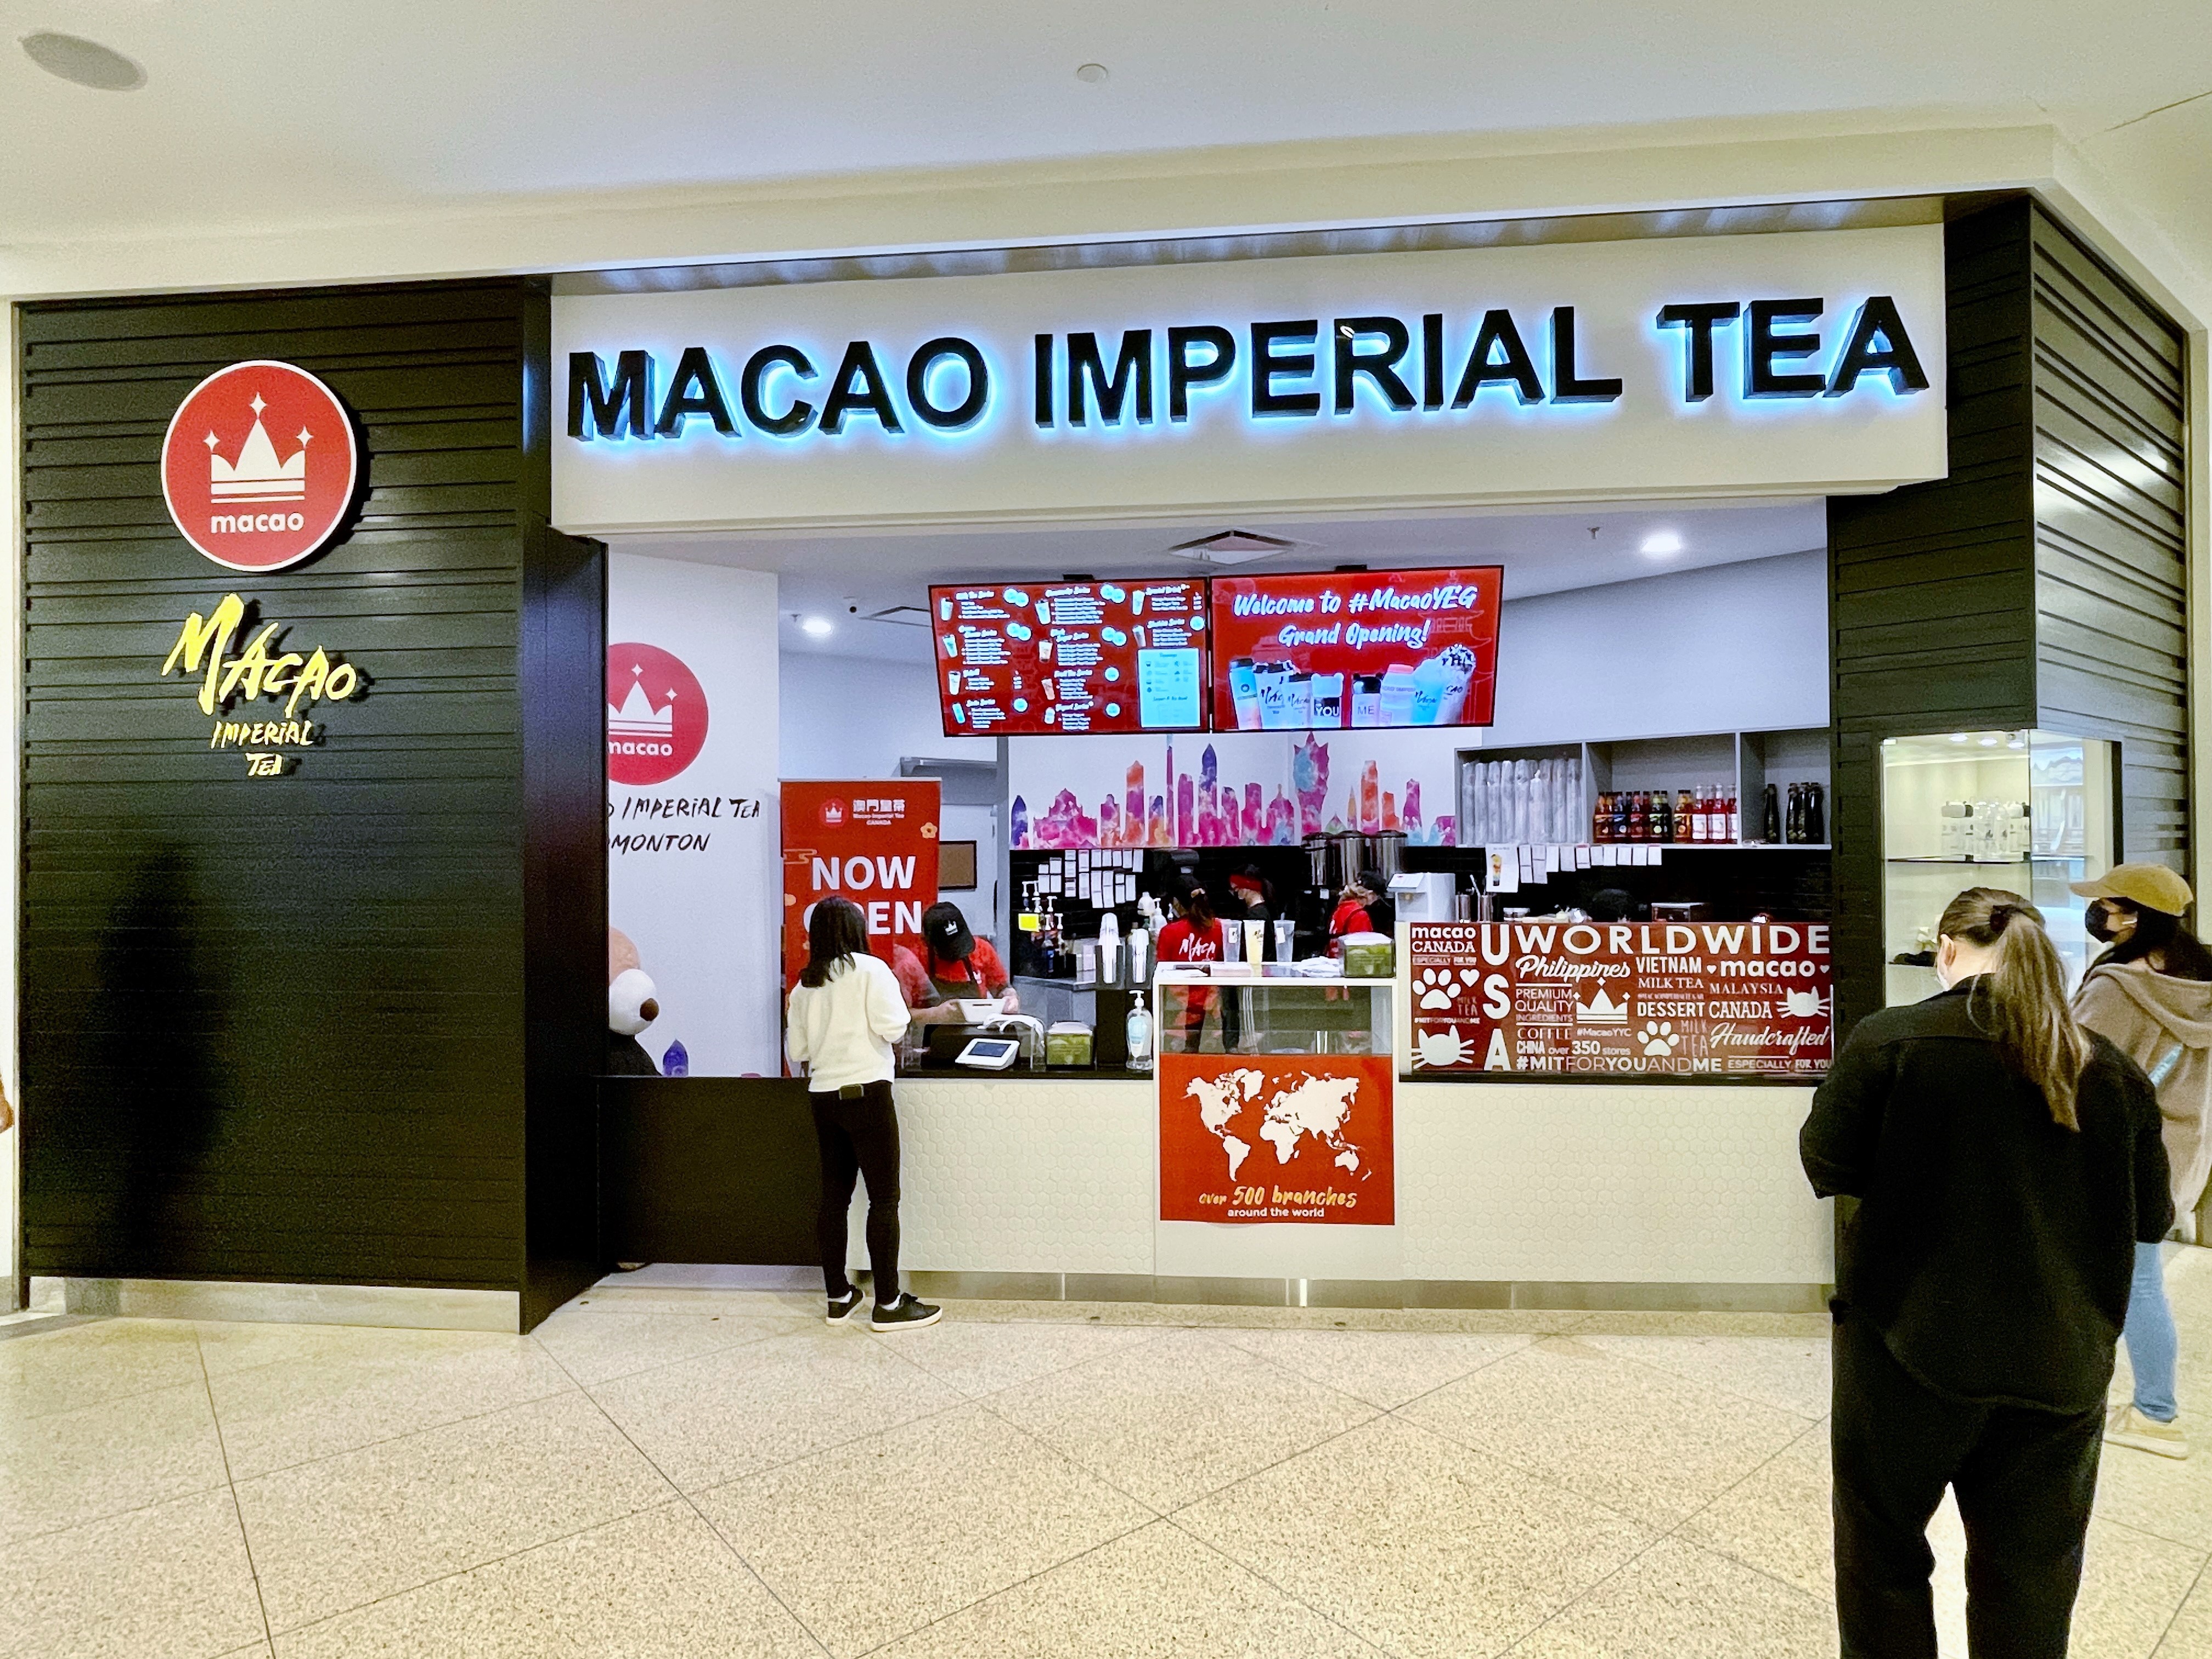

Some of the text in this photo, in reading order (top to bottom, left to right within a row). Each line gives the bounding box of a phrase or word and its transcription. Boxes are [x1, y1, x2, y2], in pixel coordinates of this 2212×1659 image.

[568, 295, 1931, 442] MACAO IMPERIAL TEA
[211, 512, 304, 534] macao
[1233, 584, 1478, 616] Welcome to #MacaoYEG
[1278, 619, 1431, 650] Grand Opening!
[161, 592, 357, 718] MACAO
[1316, 706, 1340, 717] YOU
[1357, 706, 1375, 714] ME
[608, 833, 711, 855] MONTON
[811, 856, 916, 890] NOW
[803, 900, 922, 935] EN
[1412, 927, 1476, 939] macao
[1515, 925, 1830, 955] WORLDWIDE
[1412, 941, 1476, 953] CANADA
[1515, 955, 1630, 983] Philippines
[1635, 956, 1702, 974] VIETNAM
[1720, 961, 1815, 977] macao
[1638, 977, 1704, 989] MILK TEA
[1709, 983, 1784, 995] MALAYSIA
[1516, 989, 1572, 1000] PREMIUM
[1458, 1004, 1478, 1016] TEA
[1514, 1000, 1574, 1013] QUALITY
[1637, 1002, 1705, 1017] DESSERT
[1708, 1001, 1773, 1019] CANADA
[1516, 1014, 1573, 1023] INGREDIENTS
[1680, 1019, 1708, 1033] MILK
[1577, 1028, 1632, 1037] #MacaoYYC
[1709, 1022, 1830, 1056] Handcrafted
[1516, 1040, 1632, 1056] CHINA over 350 stores
[1681, 1034, 1709, 1057] TEA
[1516, 1056, 1722, 1073] #MITFORYOUANDME
[1728, 1059, 1791, 1069] ESPECIALLY
[1795, 1059, 1811, 1069] FOR
[1199, 1185, 1357, 1208] over 500 branches
[1227, 1207, 1325, 1218] around the world
